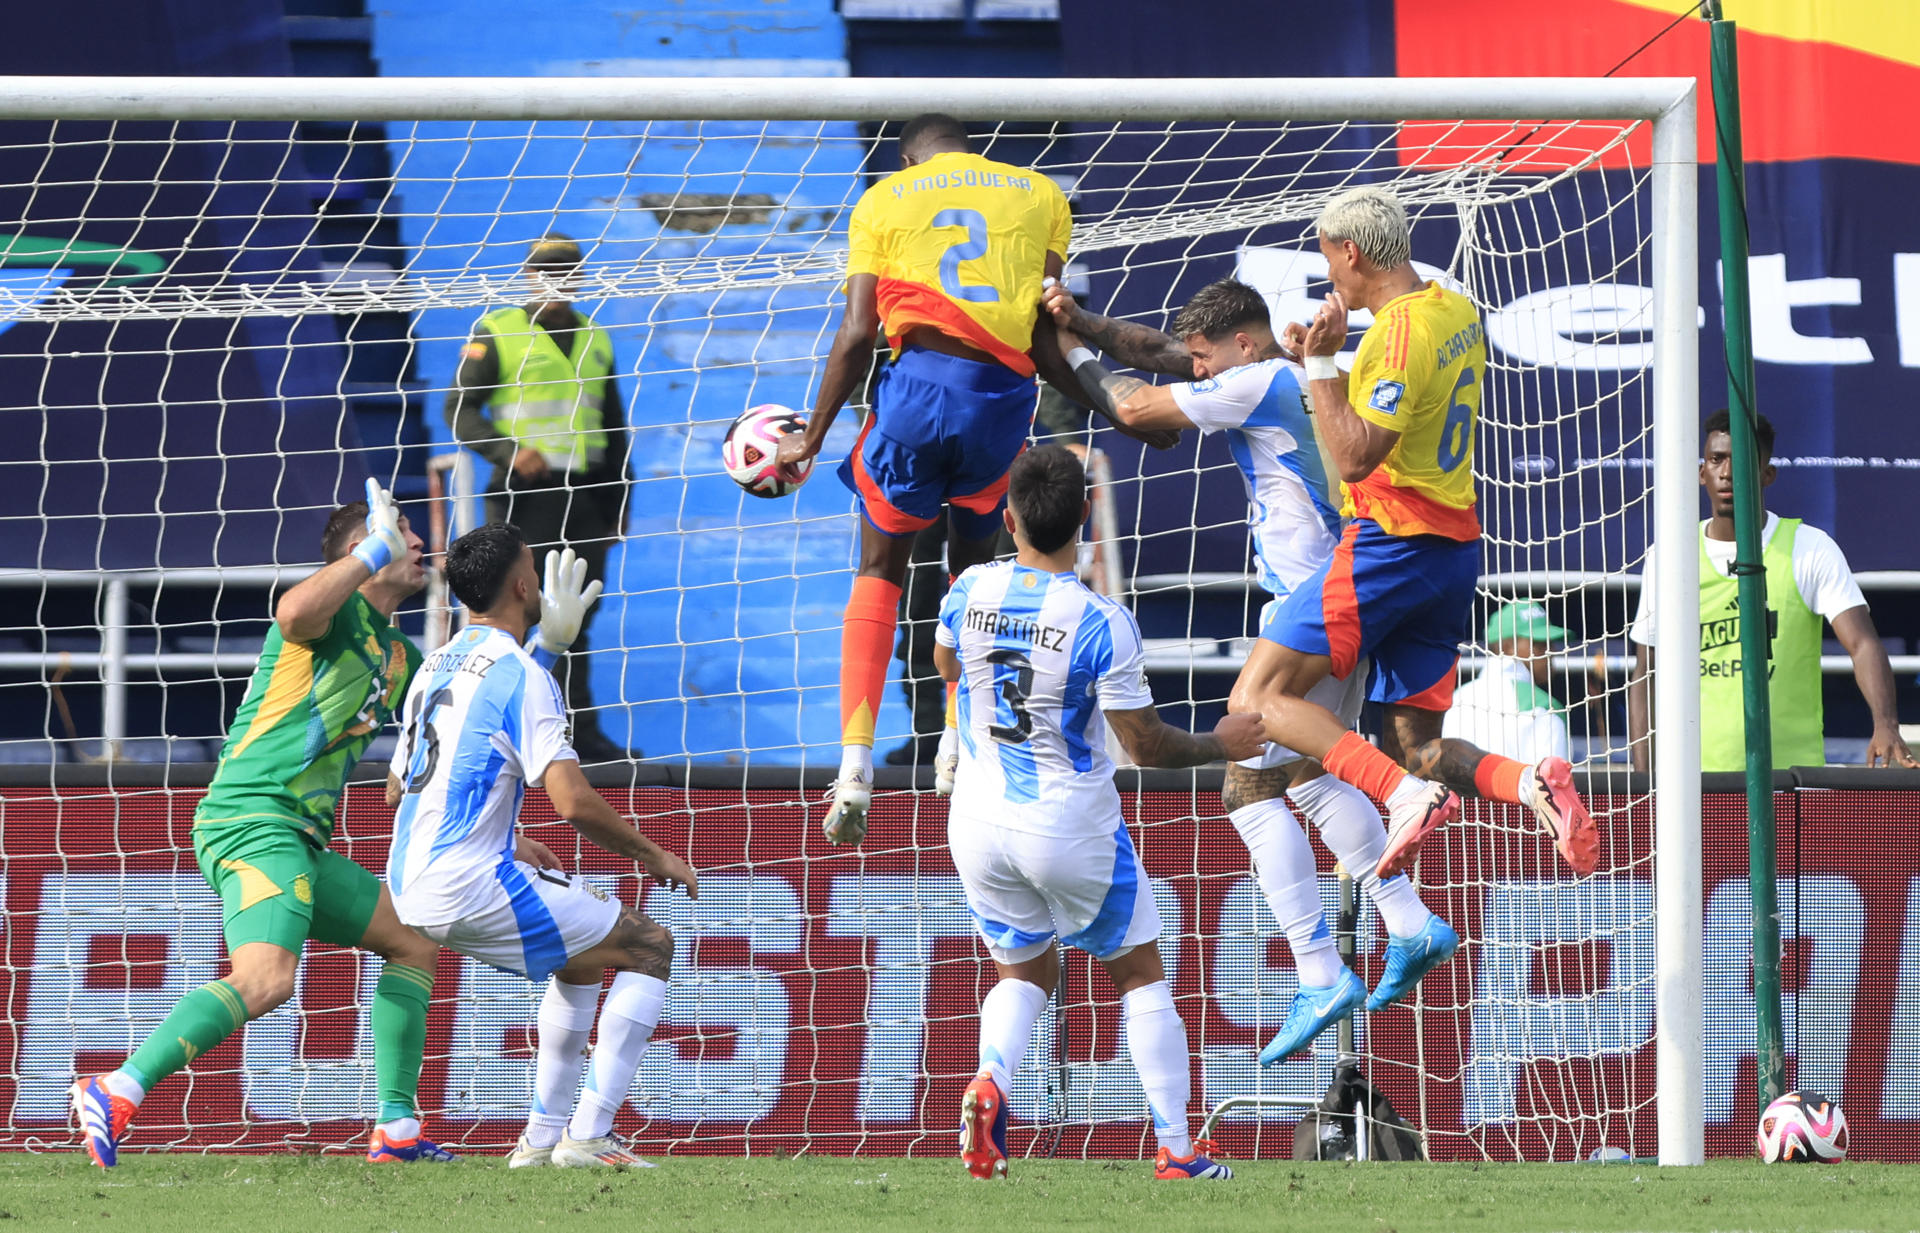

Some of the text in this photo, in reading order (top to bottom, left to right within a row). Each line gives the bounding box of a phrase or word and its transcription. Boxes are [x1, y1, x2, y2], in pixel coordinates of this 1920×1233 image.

[932, 208, 1000, 302] 2
[1437, 366, 1475, 473] 6
[967, 607, 1068, 653] MARTÍNEZ
[402, 688, 454, 794] 15
[986, 650, 1035, 744] 3
